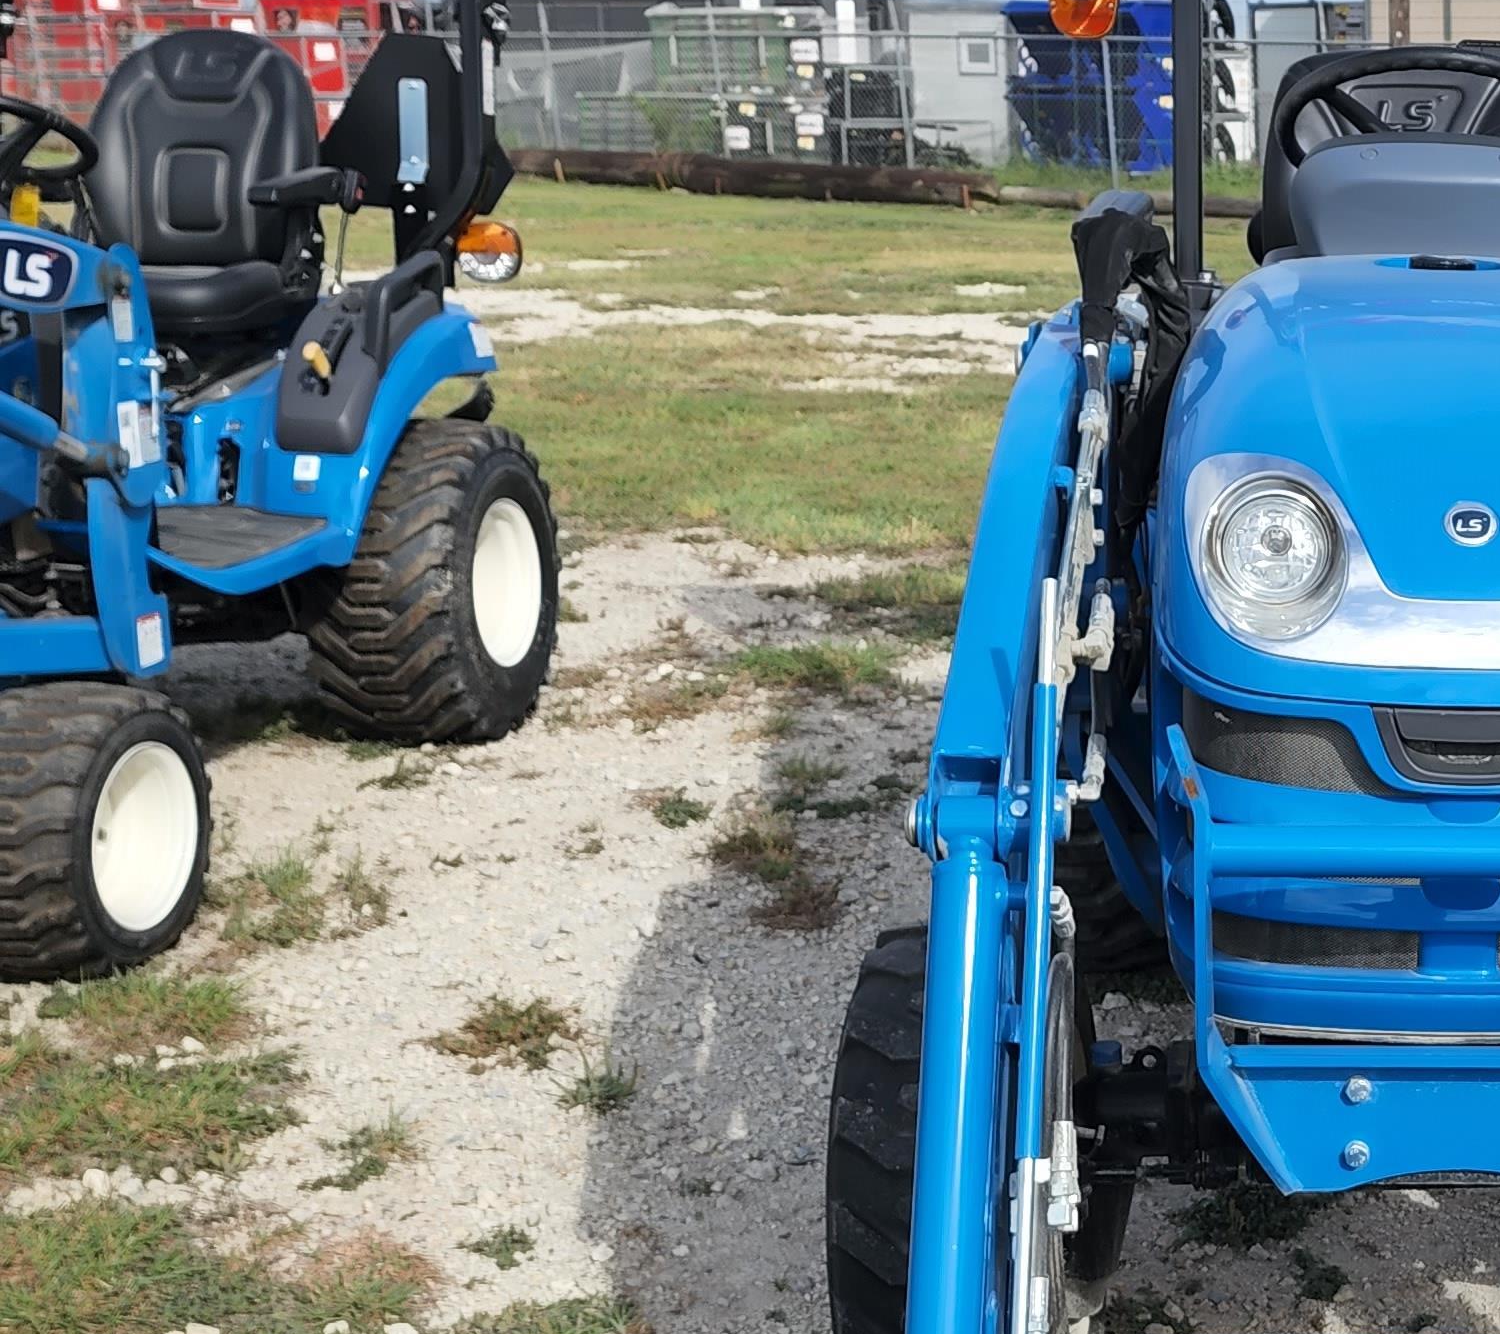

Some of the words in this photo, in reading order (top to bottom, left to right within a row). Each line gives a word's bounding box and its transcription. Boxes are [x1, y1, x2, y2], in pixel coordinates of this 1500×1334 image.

[174, 50, 237, 82] LS
[1377, 99, 1437, 132] LS
[3, 248, 52, 298] LS
[0, 310, 19, 346] S
[1456, 518, 1483, 532] LS
